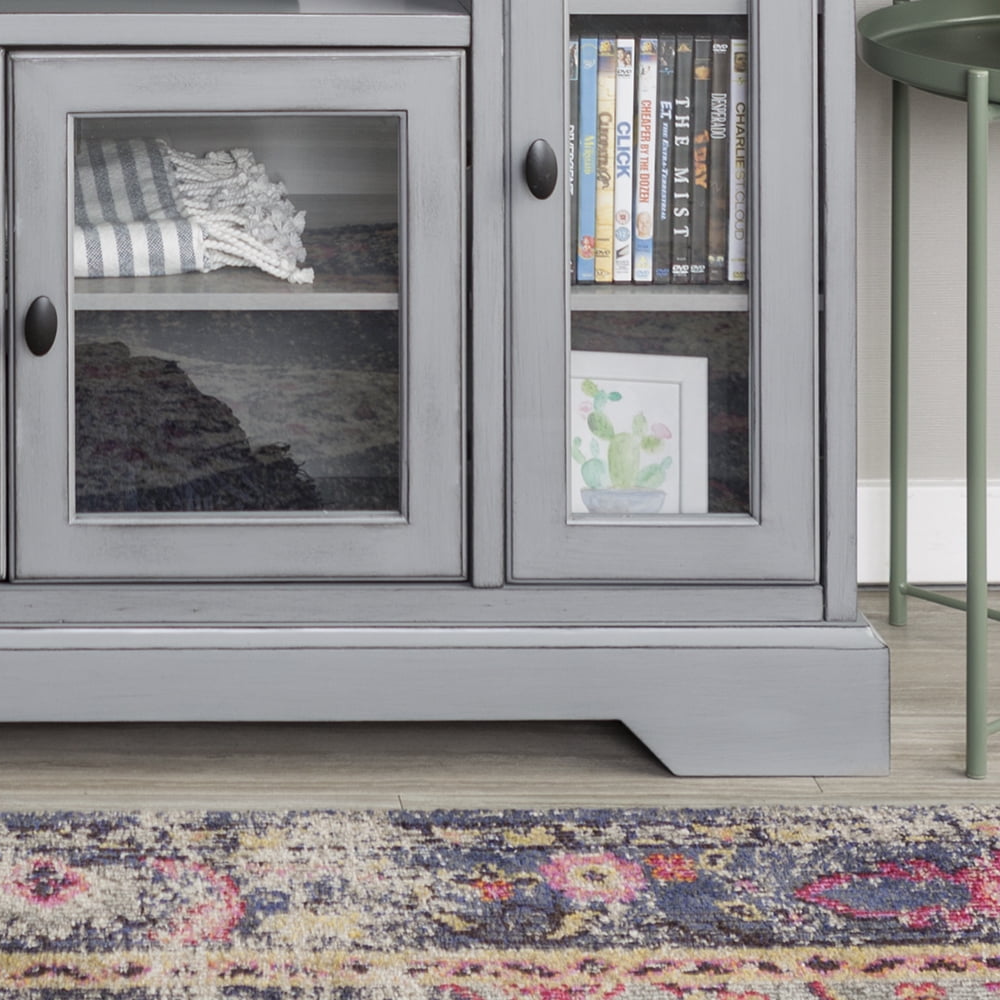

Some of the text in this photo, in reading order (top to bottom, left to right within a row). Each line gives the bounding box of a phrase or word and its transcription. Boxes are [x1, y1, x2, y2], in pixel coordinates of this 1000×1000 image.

[674, 96, 690, 147] THE
[710, 93, 727, 139] DESPERADO
[735, 102, 746, 168] CHARLIE
[616, 121, 631, 178] CLICK
[639, 100, 652, 203] CHEAPER BY THE DOZEN
[673, 167, 690, 238] MIST
[673, 264, 689, 272] DVD
